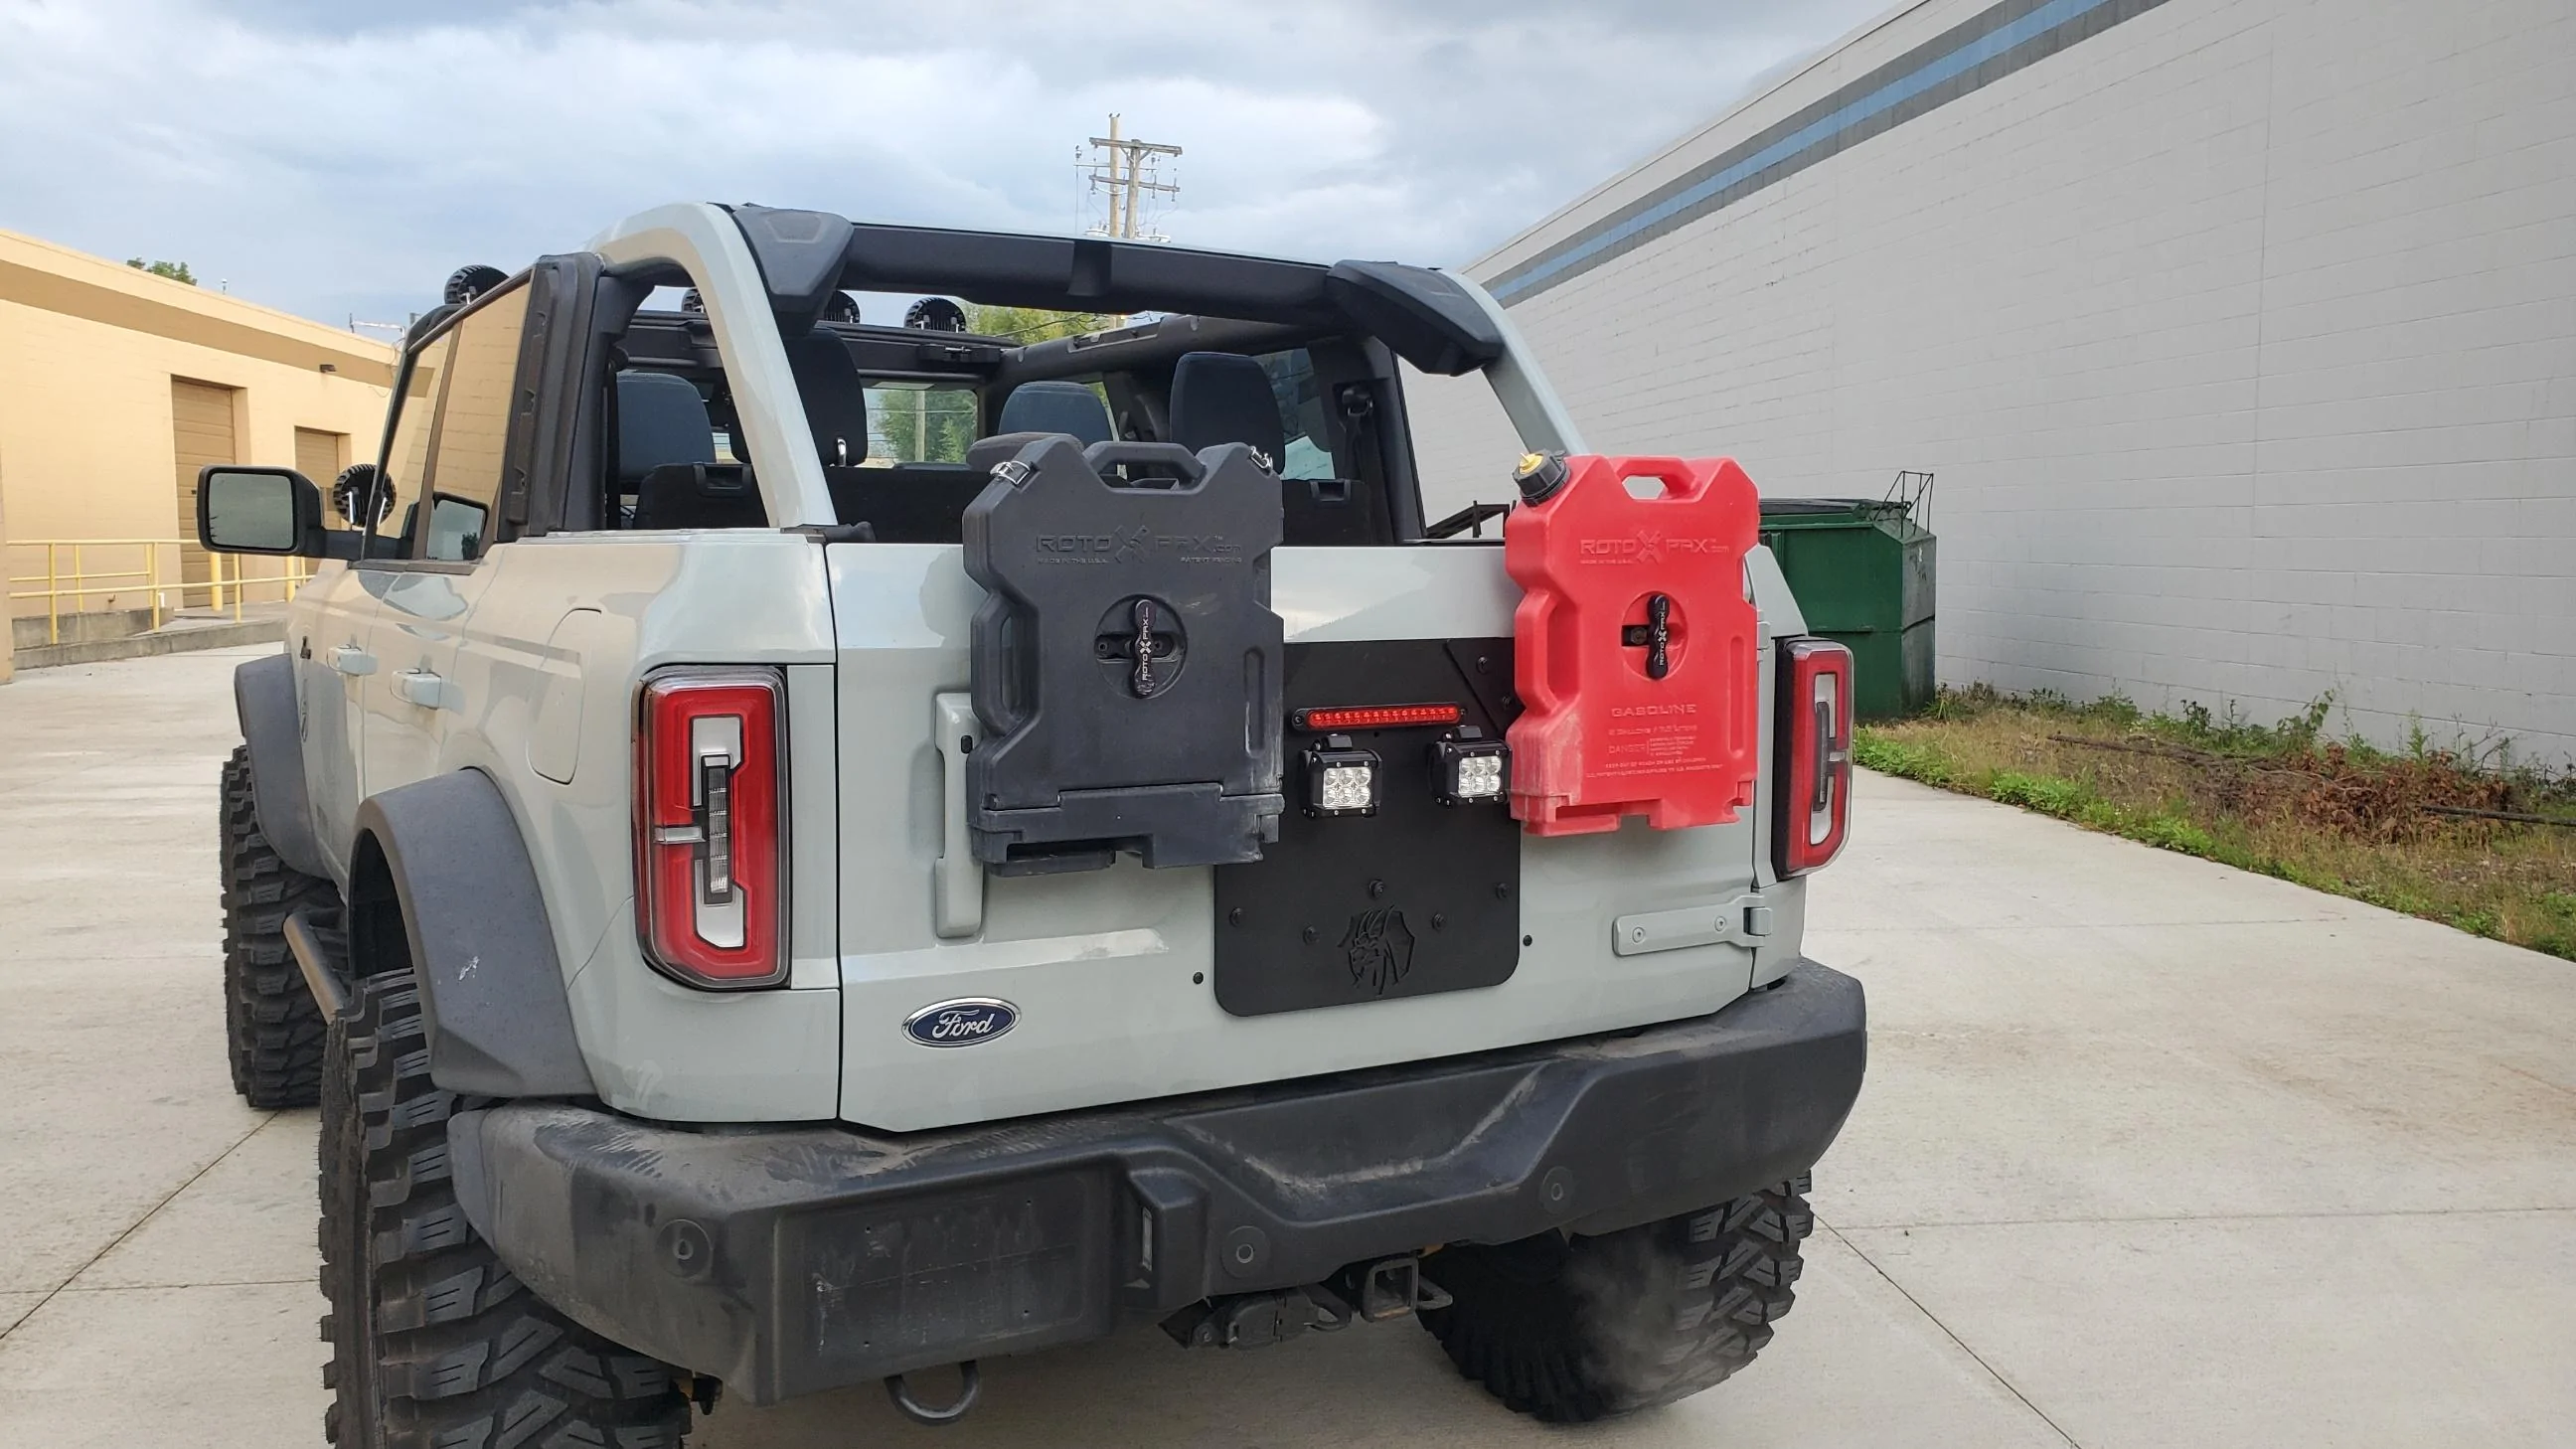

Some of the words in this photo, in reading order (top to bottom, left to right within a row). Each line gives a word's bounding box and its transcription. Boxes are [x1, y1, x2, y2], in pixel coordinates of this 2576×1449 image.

[1037, 535, 1113, 553] ROTO
[1579, 539, 1636, 555] ROTO
[1611, 704, 1696, 718] GASOLINE
[931, 1009, 996, 1039] Ford
